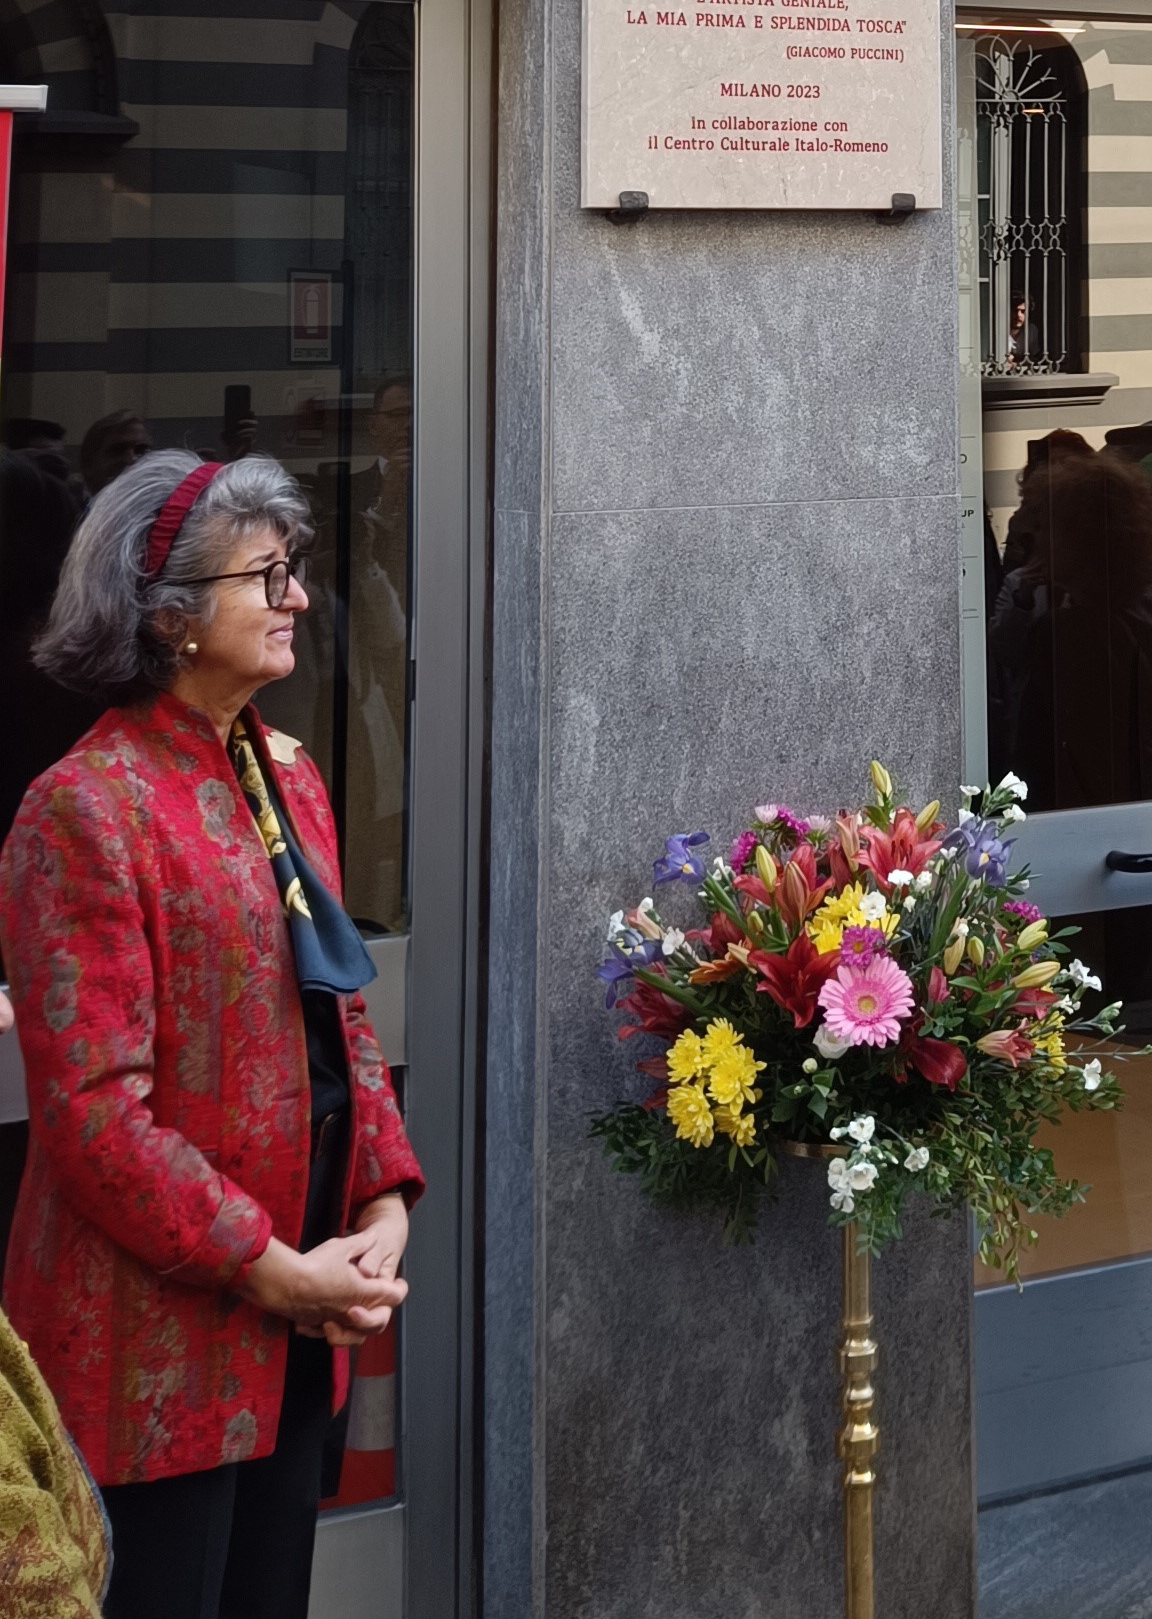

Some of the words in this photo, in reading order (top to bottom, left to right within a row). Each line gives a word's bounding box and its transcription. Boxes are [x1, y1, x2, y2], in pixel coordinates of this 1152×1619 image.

[626, 10, 649, 26] LA
[655, 11, 688, 28] MIA
[694, 12, 747, 29] PRIMA
[753, 14, 764, 31] E
[770, 14, 852, 33] SPLENDIDA
[855, 19, 907, 36] TOSCA"
[785, 45, 846, 60] (GIACOMO
[850, 47, 905, 63] PUCCINI)
[719, 82, 783, 99] MILANO
[786, 84, 822, 100] 2023
[691, 116, 707, 132] in
[711, 115, 818, 135] collaborazione
[823, 120, 849, 134] con
[647, 135, 659, 150] il
[663, 135, 715, 152] Centro
[719, 136, 792, 154] Culturale
[794, 137, 889, 154] Italo-Romeno
